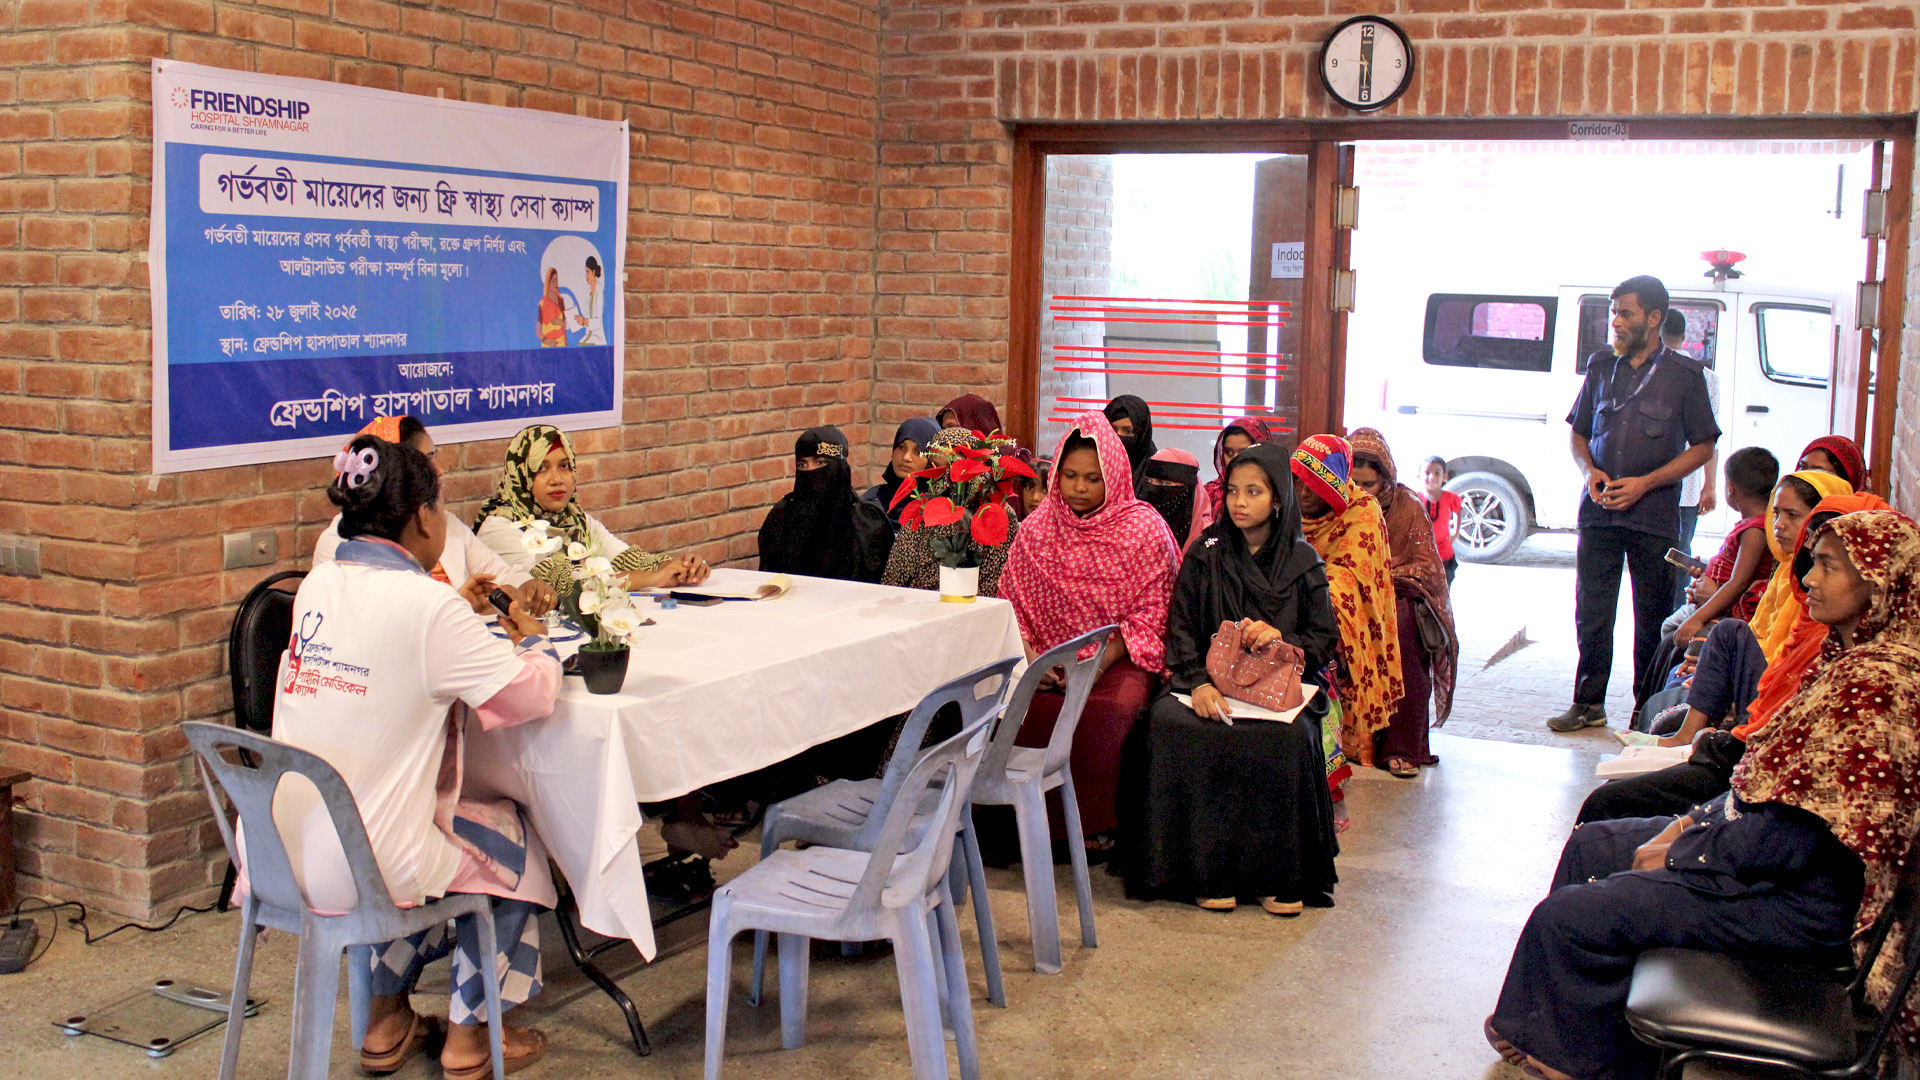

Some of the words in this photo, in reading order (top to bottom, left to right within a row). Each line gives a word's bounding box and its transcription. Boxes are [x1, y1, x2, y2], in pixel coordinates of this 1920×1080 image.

[1361, 26, 1374, 37] 12
[1331, 58, 1338, 68] 9
[1395, 58, 1402, 69] 3
[190, 89, 310, 120] FRIENDSHIP
[1361, 90, 1369, 101] 6
[190, 123, 214, 131] CARING
[232, 127, 255, 135] BETTER
[191, 111, 241, 126] HOSPITAL
[243, 116, 309, 132] SHYAMNAGAR
[1570, 123, 1626, 136] Corridor-03
[218, 164, 297, 206] গর্ভবতী
[303, 177, 386, 210] মায়েদের
[391, 185, 430, 214] জন্য
[435, 180, 458, 217] ফ্রি
[463, 189, 505, 223] স্বাস্থ্য
[510, 194, 546, 220] সেবা
[550, 196, 595, 223] ক্যাম্প
[204, 223, 249, 246] গর্ভবতী
[251, 229, 301, 247] মায়েদের
[304, 231, 331, 249] প্রসব
[334, 228, 371, 253] পূর্ববর্তী
[373, 234, 400, 253] স্বাস্থ্য
[402, 230, 437, 254] পরীক্ষা,
[439, 237, 461, 251] রক্তে
[462, 237, 482, 253] গ্রুপ
[483, 234, 505, 253] নির্ণয়
[507, 239, 527, 255] এবং
[279, 255, 346, 278] আল্ট্রাসাউন্ড
[349, 256, 383, 277] পরীক্ষা
[385, 257, 416, 281] সম্পূর্ণ
[417, 258, 438, 278] বিনা
[266, 304, 285, 322] ২৮
[288, 300, 322, 324] জুলাই
[324, 304, 358, 321] ২০২৫
[253, 331, 303, 354] ফ্রেন্ডশিপ
[305, 333, 361, 352] হাসপাতাল
[362, 332, 408, 349] শ্যামনগর
[270, 388, 367, 429] ফ্রেন্ডশিপ
[370, 386, 473, 418] হাসপাতাল
[476, 380, 556, 410] শ্যামনগর
[332, 661, 370, 677] শ্যামনগর
[295, 684, 317, 699] ক্যাম্প
[321, 675, 368, 697] মেডিকেল
